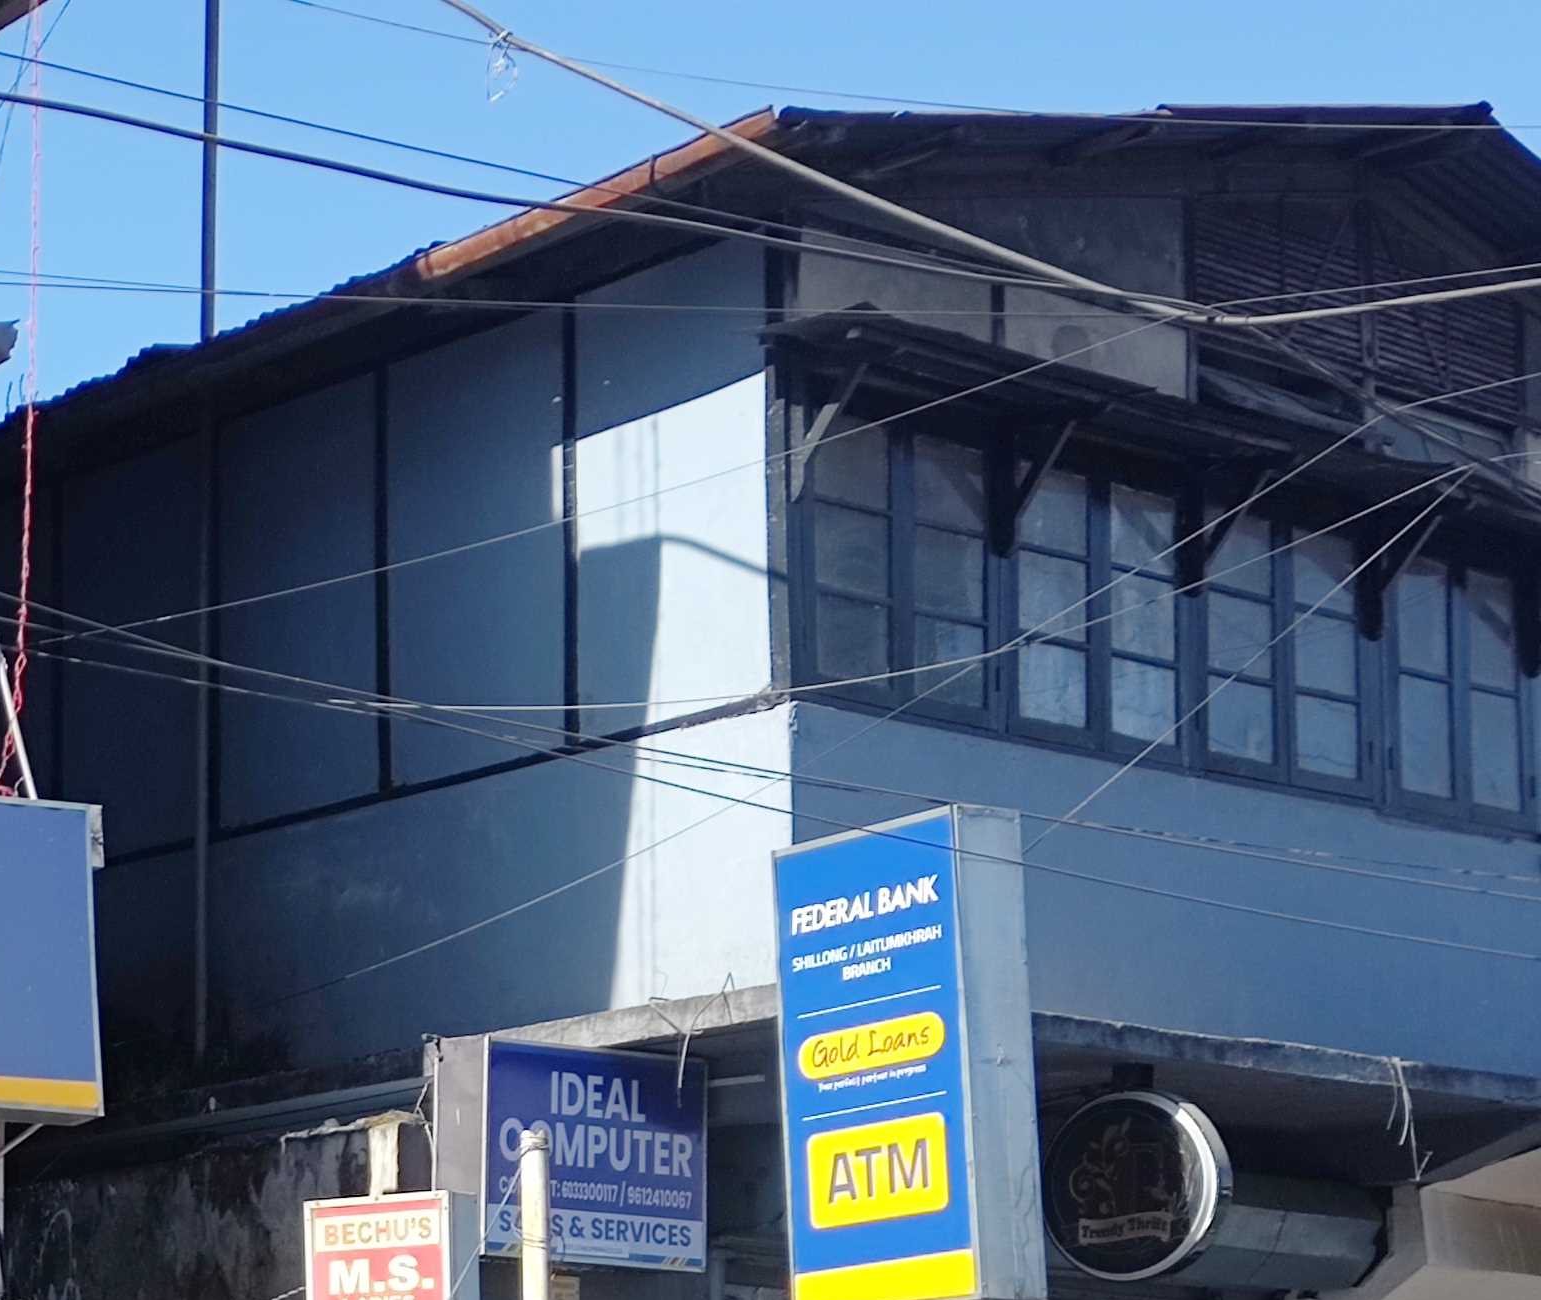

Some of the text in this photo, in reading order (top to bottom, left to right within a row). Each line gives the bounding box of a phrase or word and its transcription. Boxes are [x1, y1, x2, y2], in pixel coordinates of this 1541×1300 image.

[792, 874, 939, 935] FEDERAL BANK
[792, 924, 942, 972] SHILLONG LAITUMKHRAH
[842, 956, 891, 981] BRANCH
[812, 1020, 931, 1069] Gold Loans
[550, 1071, 645, 1122] IDEAL
[828, 1137, 931, 1205] ATM
[324, 1216, 432, 1246] BECHU'S
[569, 1216, 586, 1238] &
[591, 1219, 691, 1247] SERVICES
[329, 1254, 435, 1296] M.S.
